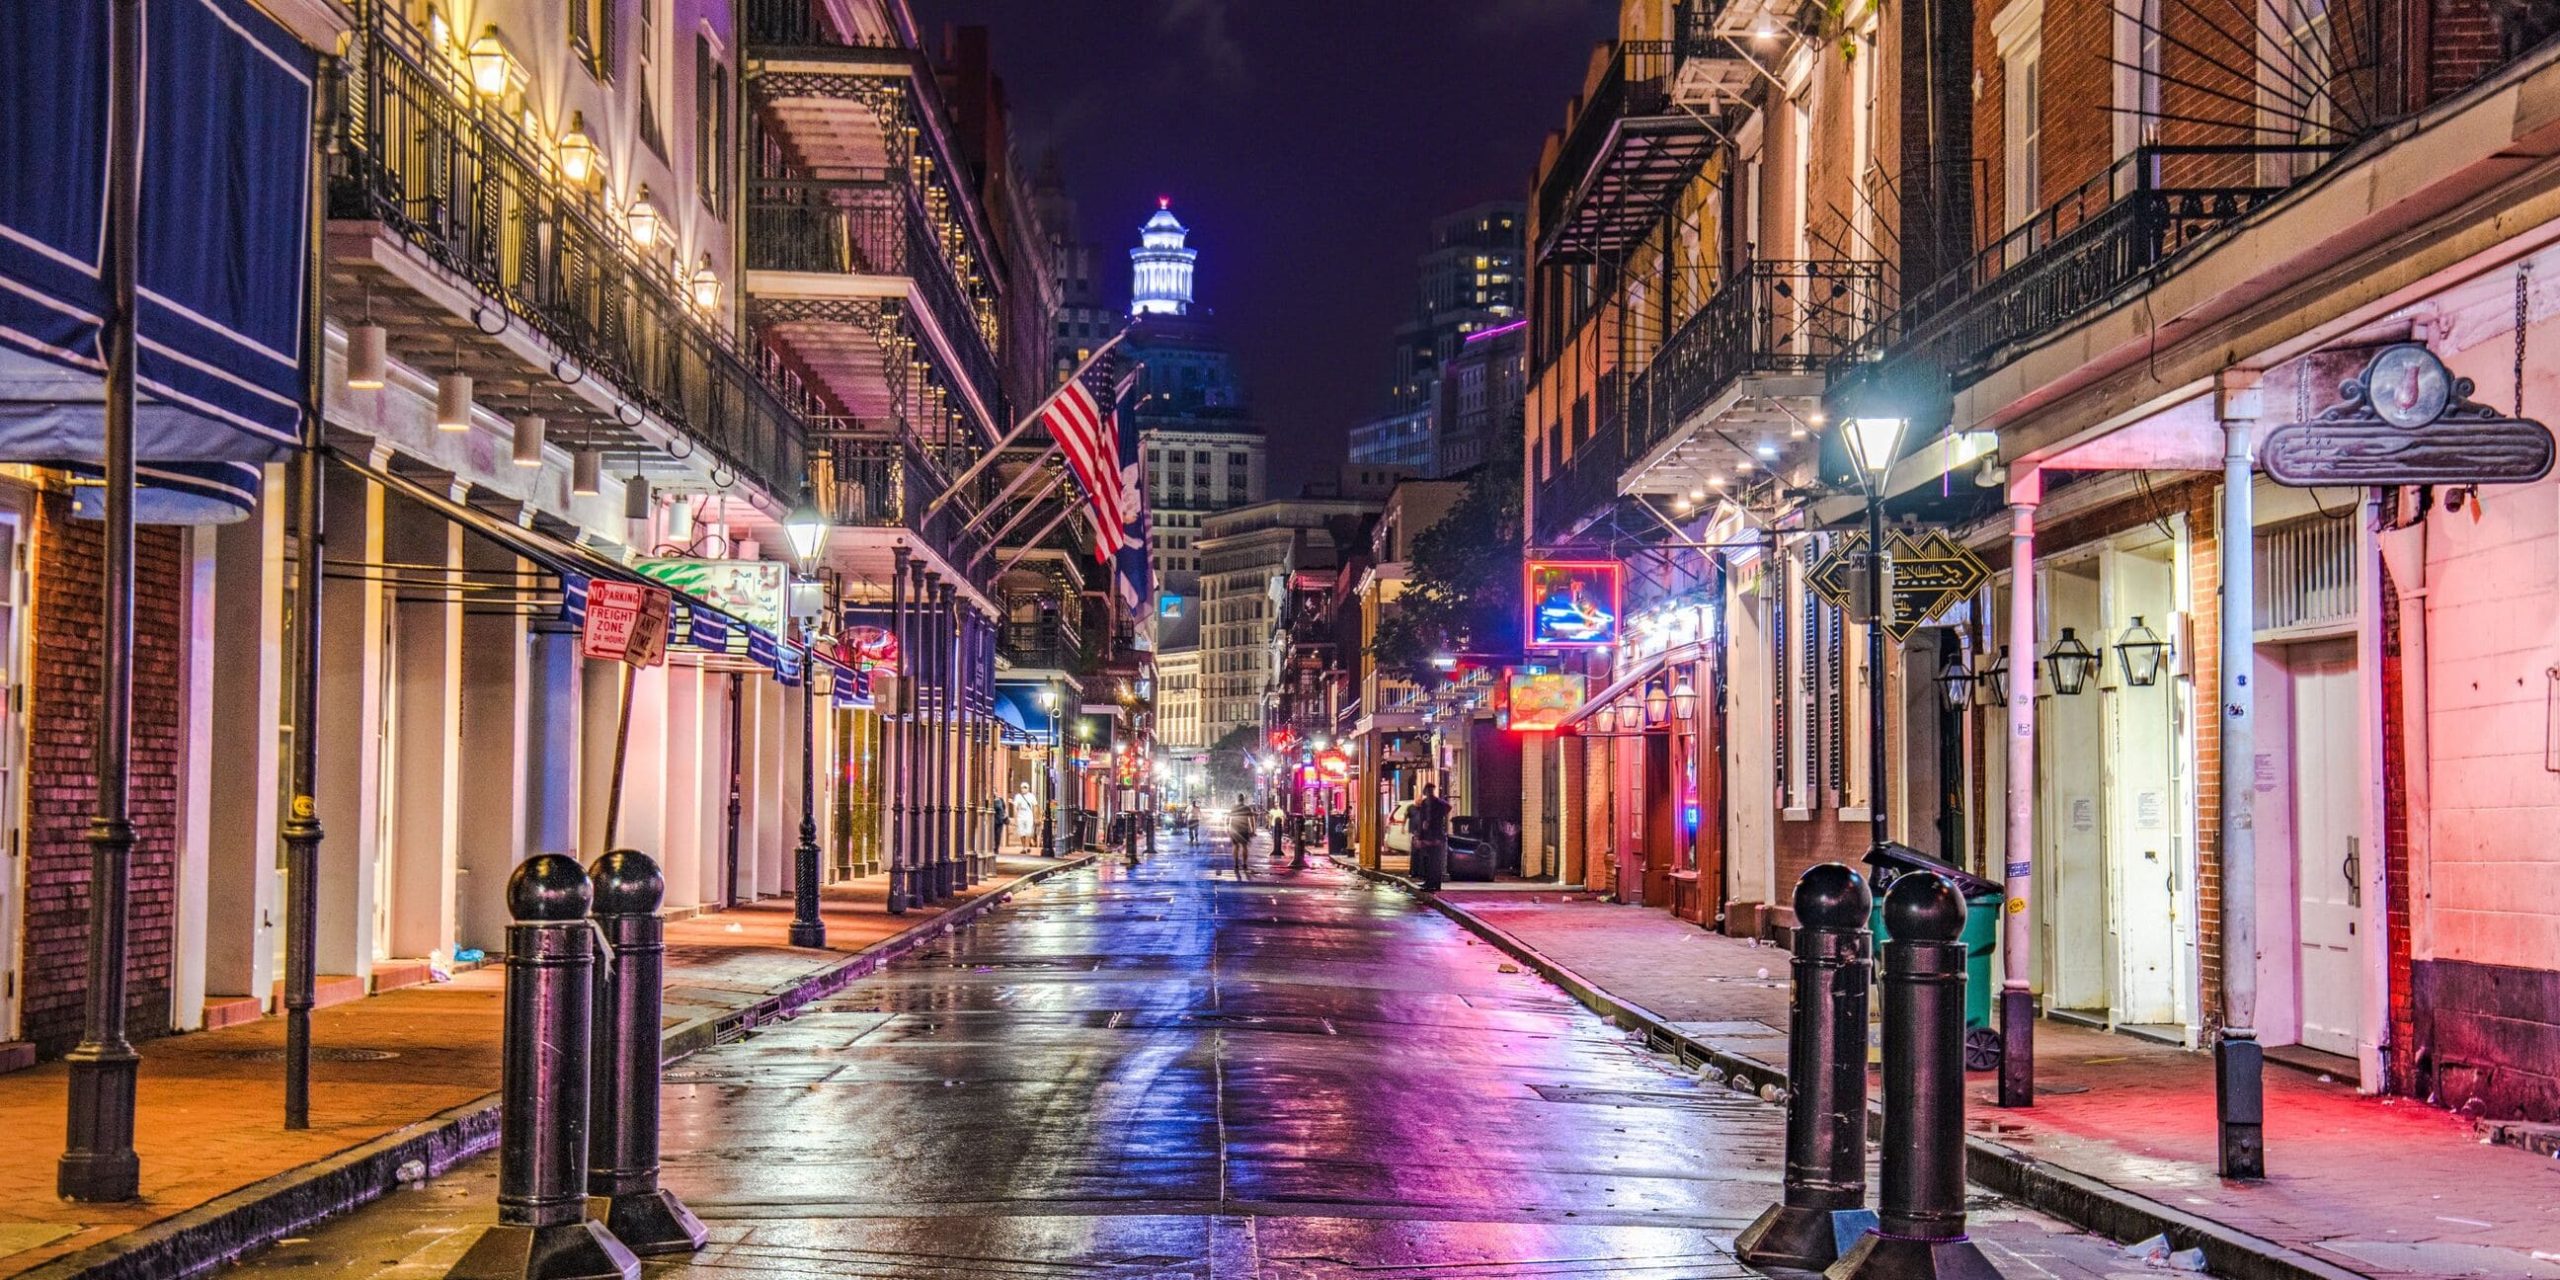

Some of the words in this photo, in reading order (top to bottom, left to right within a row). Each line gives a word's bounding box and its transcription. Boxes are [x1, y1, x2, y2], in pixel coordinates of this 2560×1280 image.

[589, 585, 604, 601] NO
[604, 590, 638, 604] PARKING
[591, 608, 633, 622] FREIGHT
[597, 620, 624, 633] ZONE
[640, 616, 656, 633] ANY
[604, 635, 625, 645] HOURS
[633, 631, 651, 649] TIME
